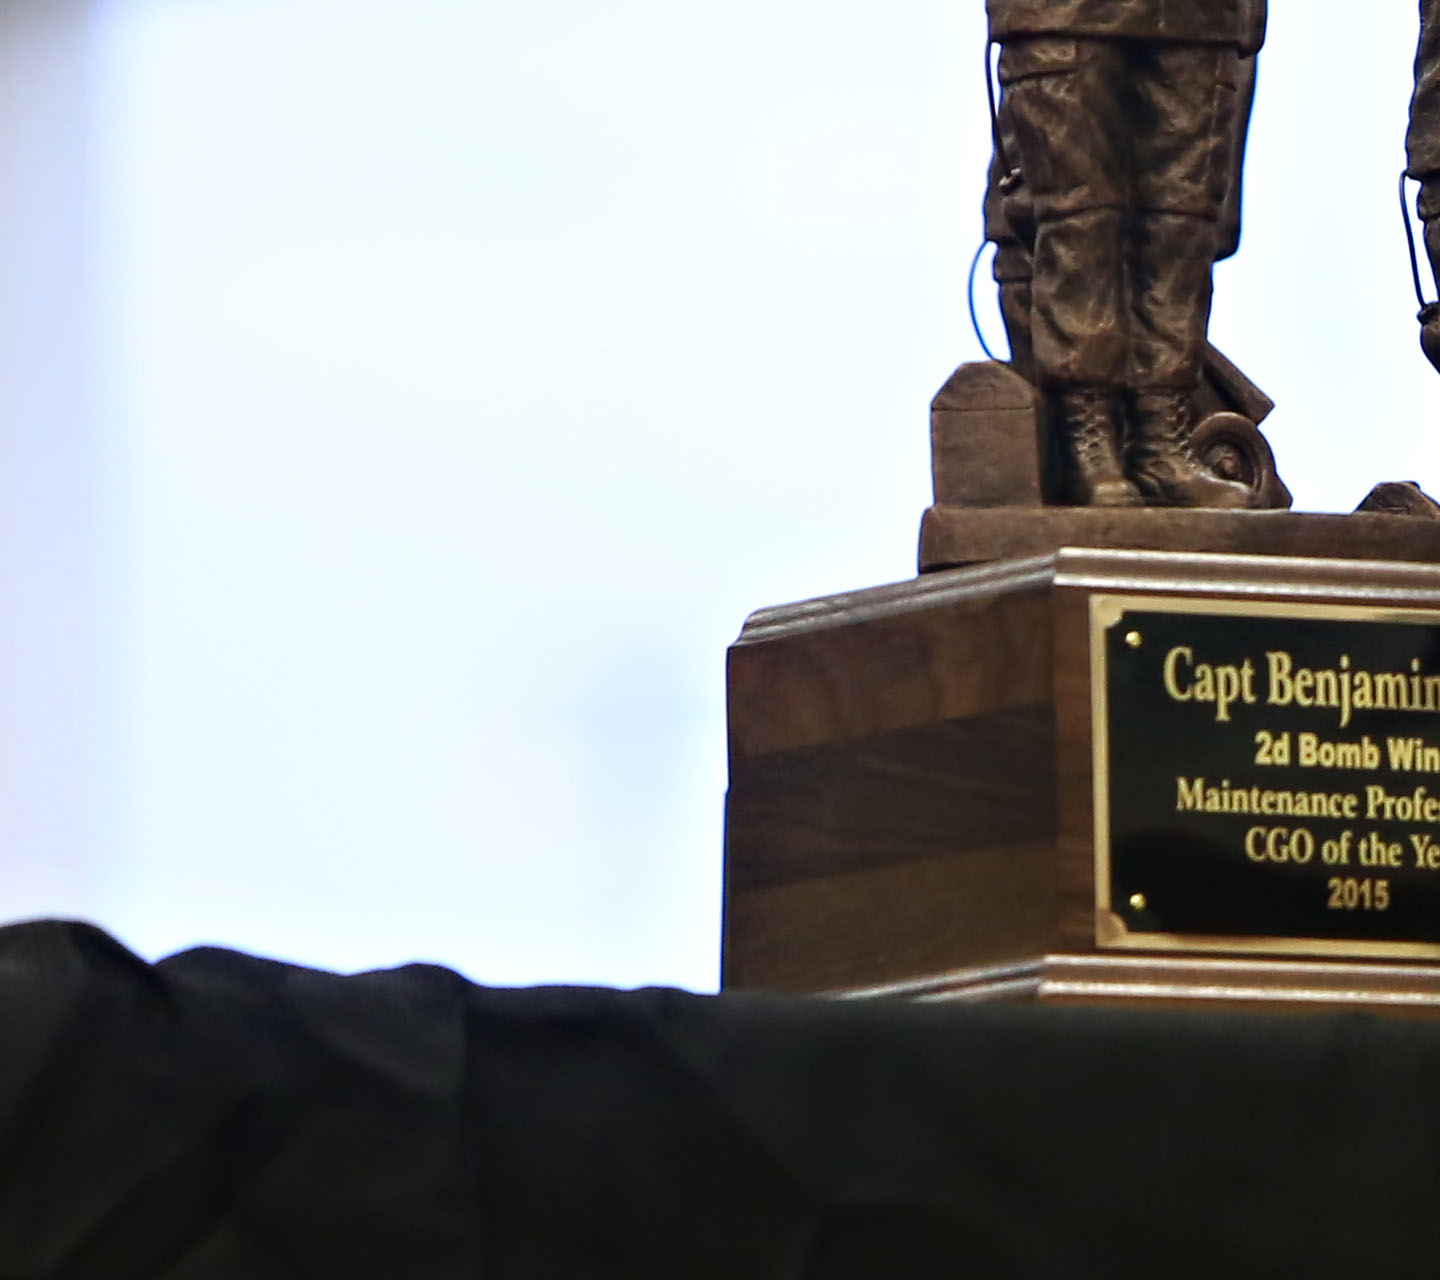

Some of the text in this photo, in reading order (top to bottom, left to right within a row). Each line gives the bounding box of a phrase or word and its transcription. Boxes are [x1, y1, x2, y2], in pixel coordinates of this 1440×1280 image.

[1164, 647, 1256, 721] Capt
[1255, 731, 1290, 765] 2d
[1299, 733, 1380, 769] Bomb
[1177, 777, 1358, 818] Maintenance
[1245, 827, 1314, 863] CGO
[1322, 830, 1352, 864] of
[1358, 832, 1402, 866] the
[1328, 877, 1389, 909] 2015
